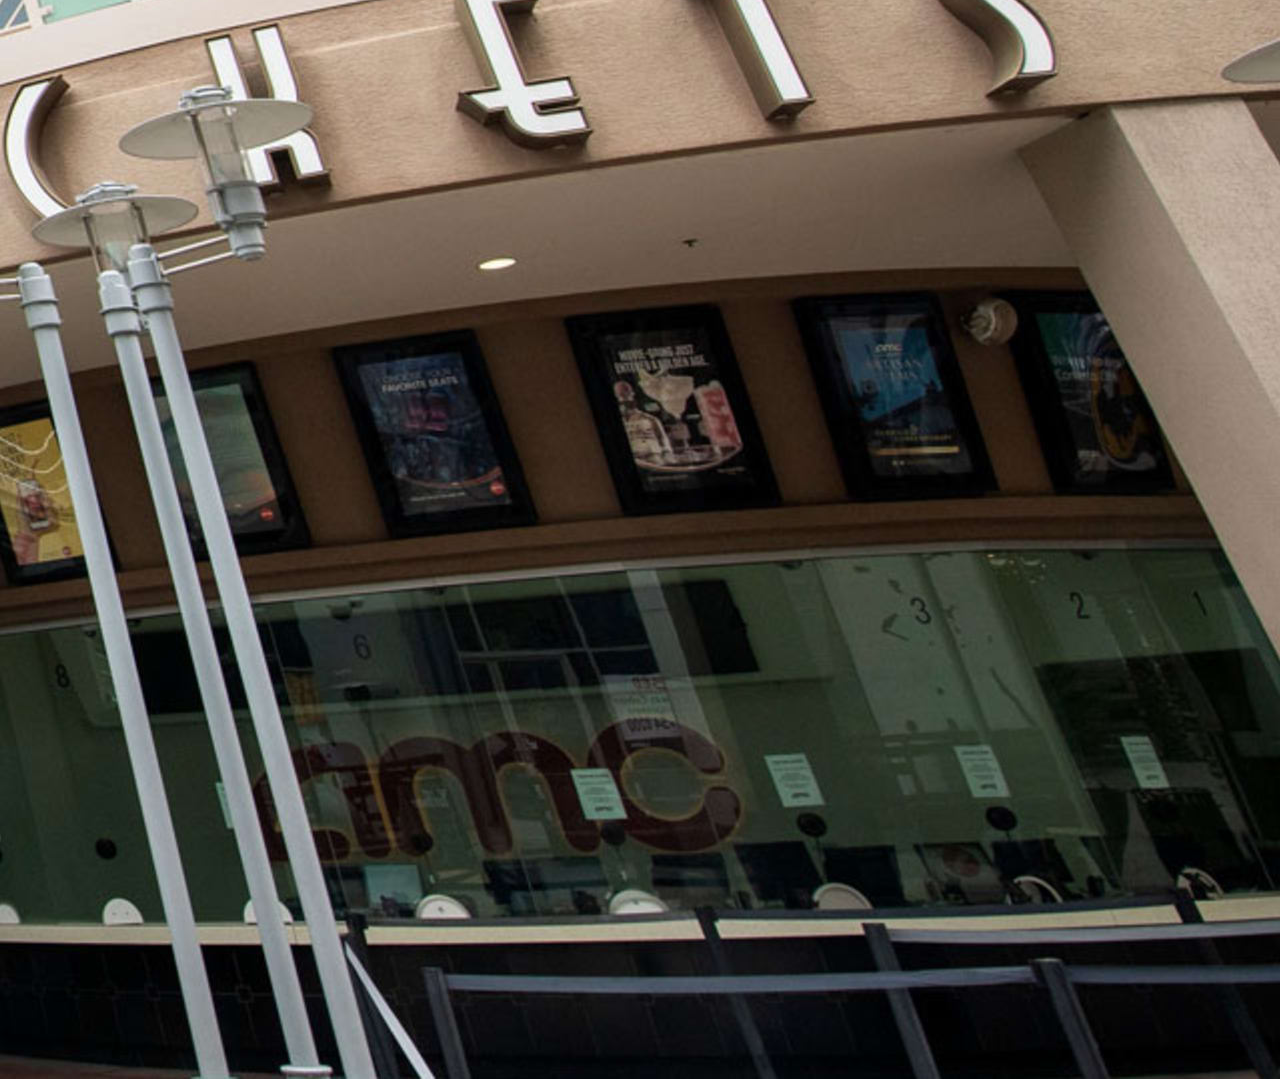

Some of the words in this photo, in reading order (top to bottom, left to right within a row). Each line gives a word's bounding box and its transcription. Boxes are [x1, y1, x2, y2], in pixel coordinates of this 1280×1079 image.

[910, 597, 931, 624] 3
[1069, 591, 1090, 619] 2
[1192, 590, 1207, 617] 1
[352, 633, 372, 660] 6
[54, 663, 70, 688] 8
